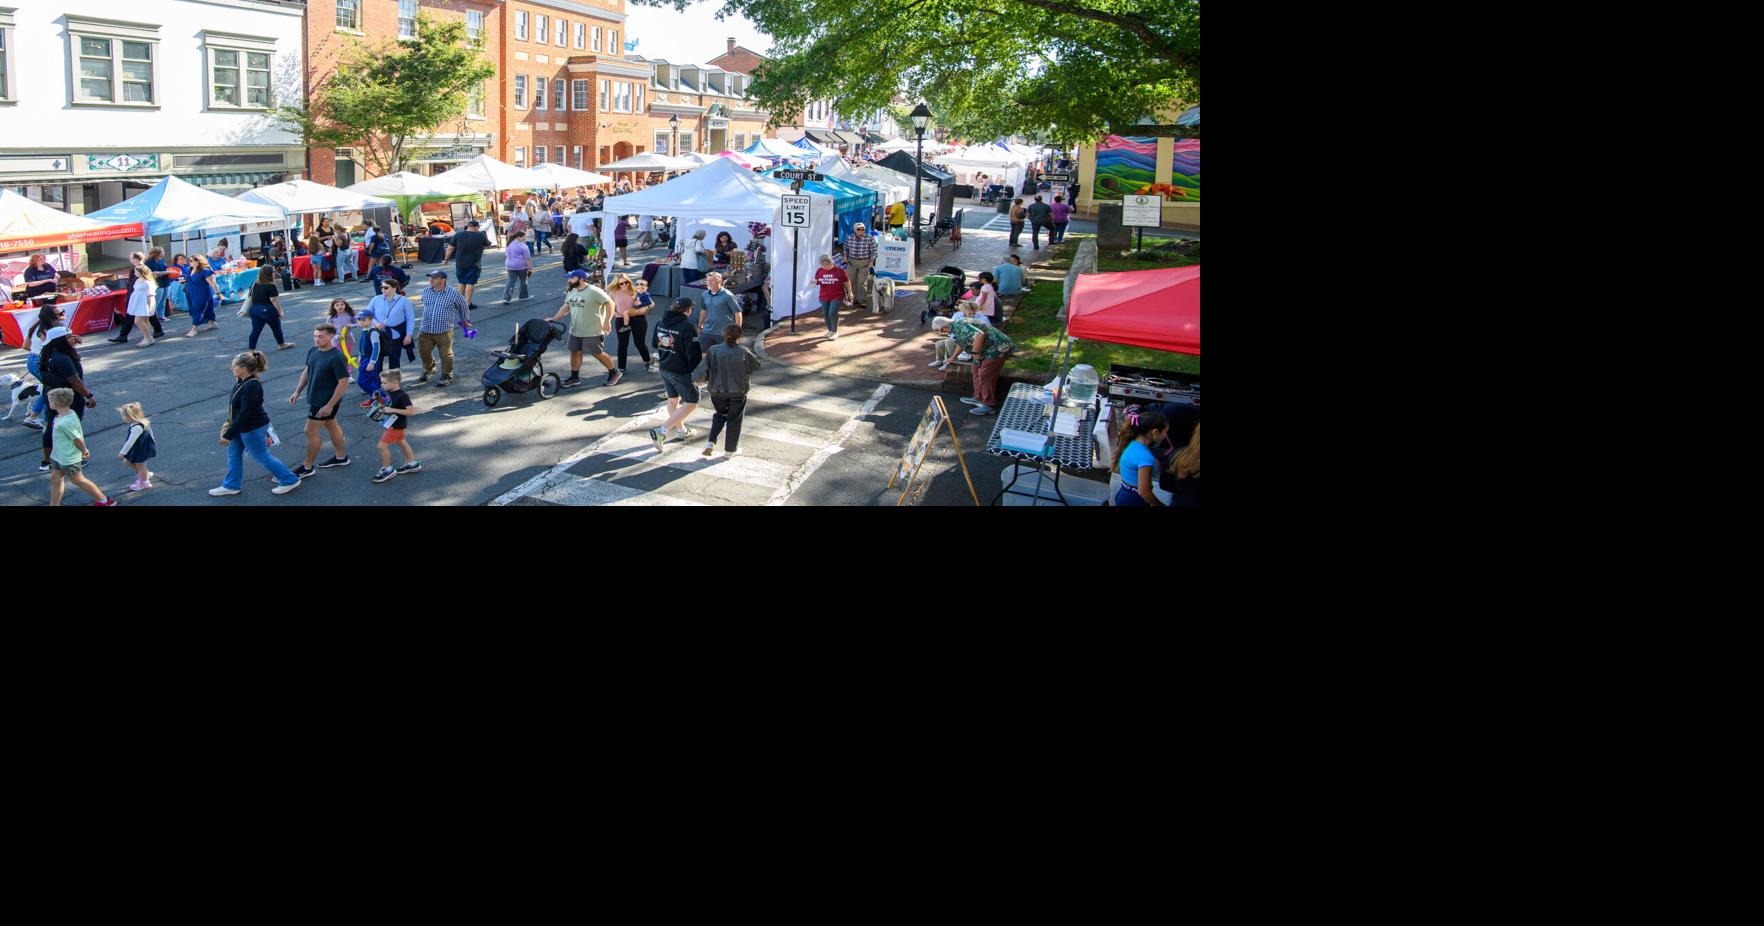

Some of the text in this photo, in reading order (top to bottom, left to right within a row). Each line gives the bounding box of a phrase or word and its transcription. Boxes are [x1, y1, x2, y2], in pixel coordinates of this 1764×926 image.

[117, 157, 130, 167] 11
[780, 172, 804, 180] COURT
[786, 212, 805, 224] 15
